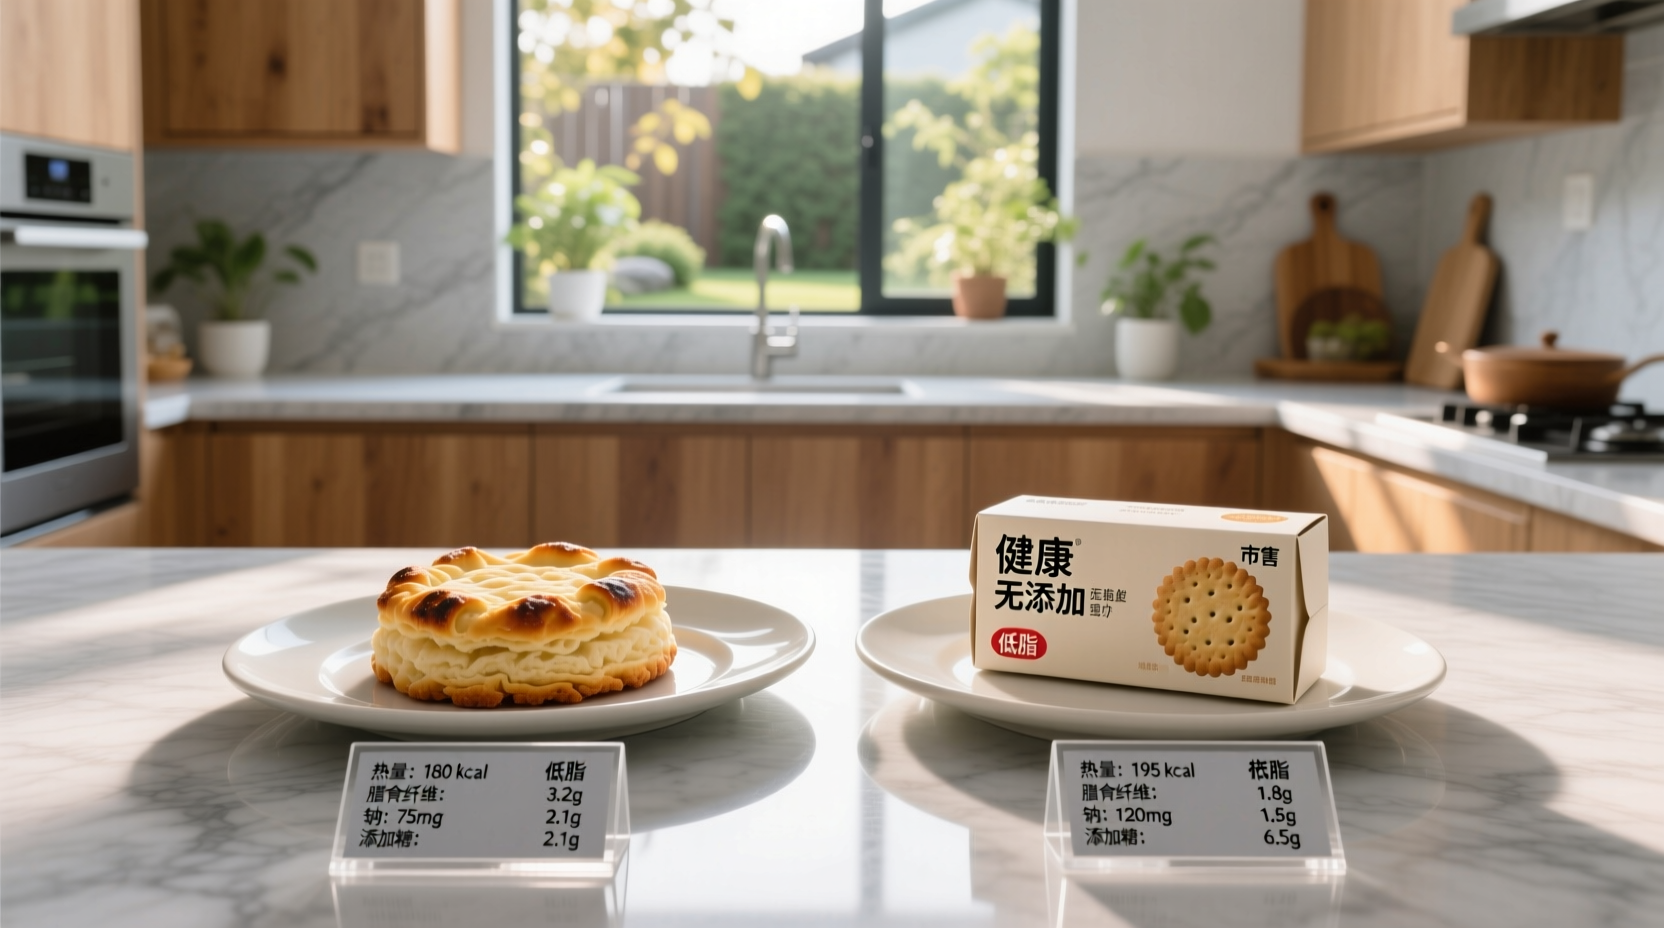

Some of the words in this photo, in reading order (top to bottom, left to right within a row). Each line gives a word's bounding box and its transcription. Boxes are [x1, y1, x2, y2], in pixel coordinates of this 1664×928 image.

[996, 534, 1074, 578] 健康
[995, 580, 1085, 616] 无添加
[998, 632, 1038, 656] 低脂
[425, 764, 452, 779] 180
[456, 763, 488, 779] kcal
[545, 761, 586, 782] 低脂
[1132, 762, 1160, 777] 195
[1165, 762, 1195, 778] kcal
[547, 787, 583, 806] 3.2g
[1258, 785, 1292, 804] 1.8g
[398, 809, 444, 828] 75mg
[546, 809, 581, 828] 2.1g
[1116, 807, 1172, 826] 120mg
[1260, 807, 1296, 827] 1.5g
[543, 831, 579, 851] 2.1g
[1264, 829, 1301, 850] 6.5g
